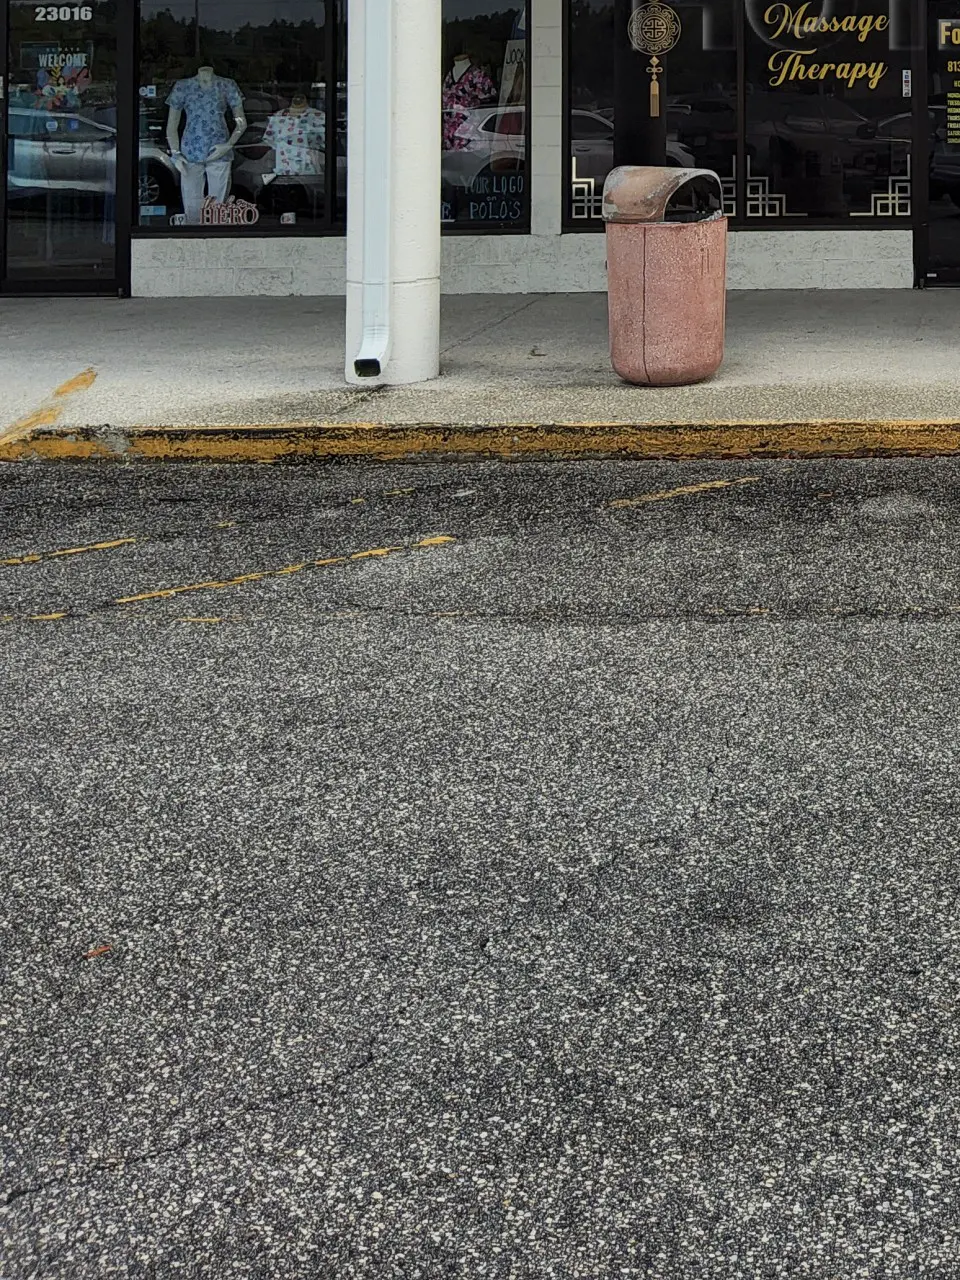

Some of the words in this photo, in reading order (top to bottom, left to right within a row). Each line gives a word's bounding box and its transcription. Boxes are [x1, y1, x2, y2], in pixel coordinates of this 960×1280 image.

[35, 6, 93, 22] 23016
[764, 2, 890, 42] Massage
[38, 53, 88, 67] WELCOME
[767, 48, 889, 89] Therapy
[493, 176, 524, 194] LOGO
[200, 206, 259, 225] HERO
